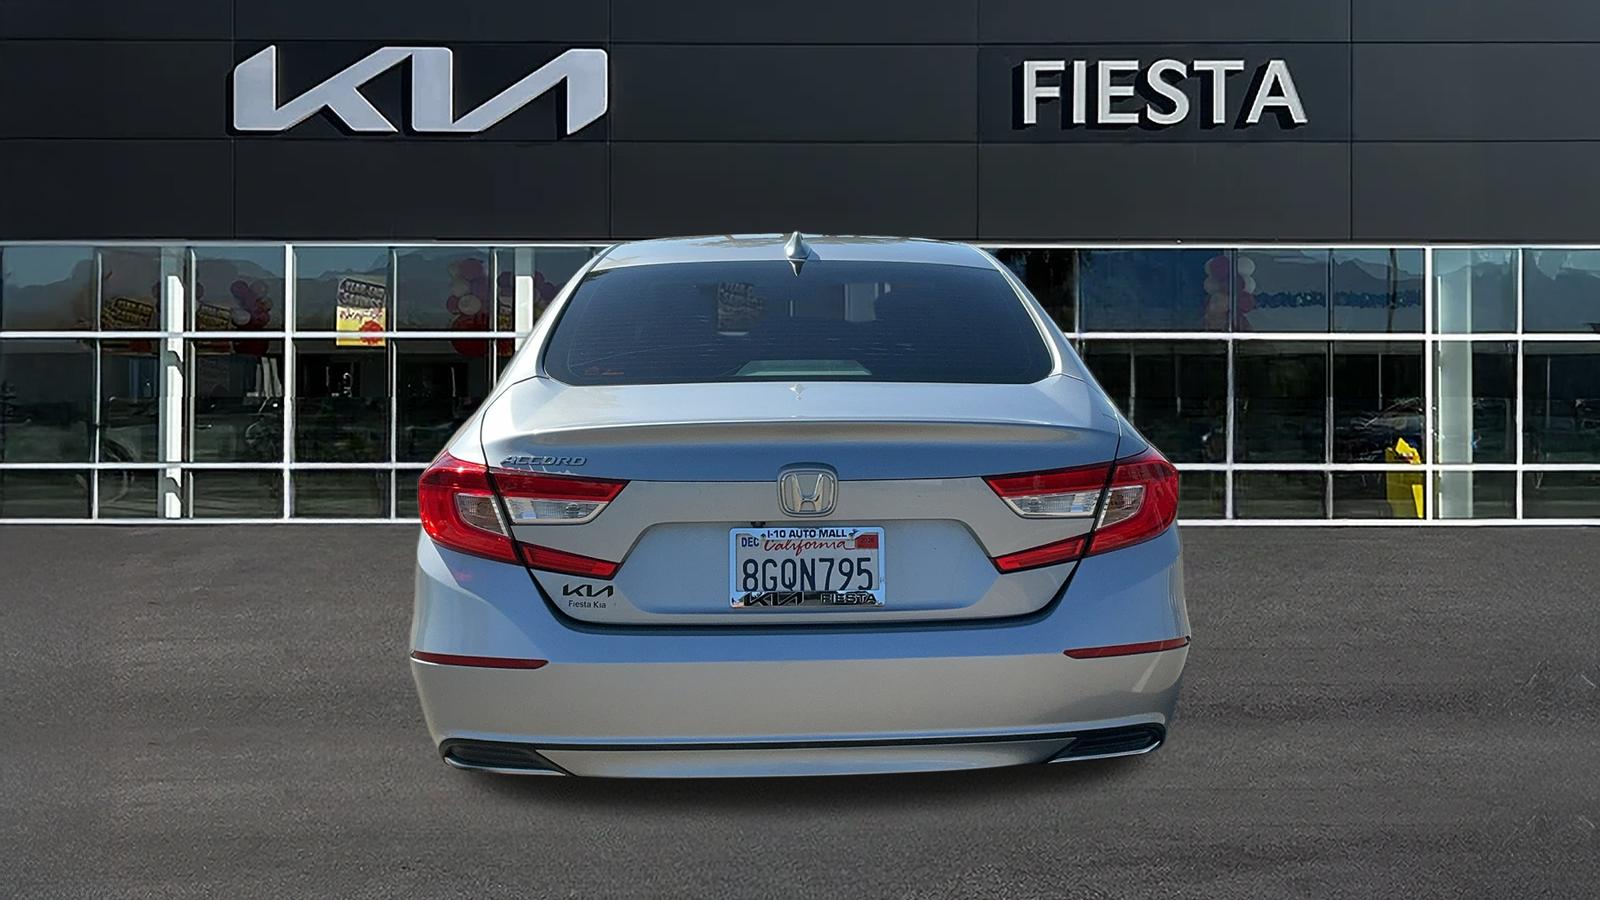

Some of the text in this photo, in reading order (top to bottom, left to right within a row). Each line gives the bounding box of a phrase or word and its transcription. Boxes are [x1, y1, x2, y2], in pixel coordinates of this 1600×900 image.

[233, 44, 608, 135] KIA
[1023, 58, 1308, 125] FIESTA
[500, 455, 588, 467] ACCORD
[767, 529, 847, 538] I-10 AUTO MALL
[741, 537, 760, 547] DEC
[763, 539, 856, 556] California
[742, 557, 873, 591] 8GQN795
[562, 583, 614, 598] KIA
[568, 600, 607, 609] Fiesta Kia
[743, 591, 805, 607] KIA
[820, 592, 878, 606] FIESTA
